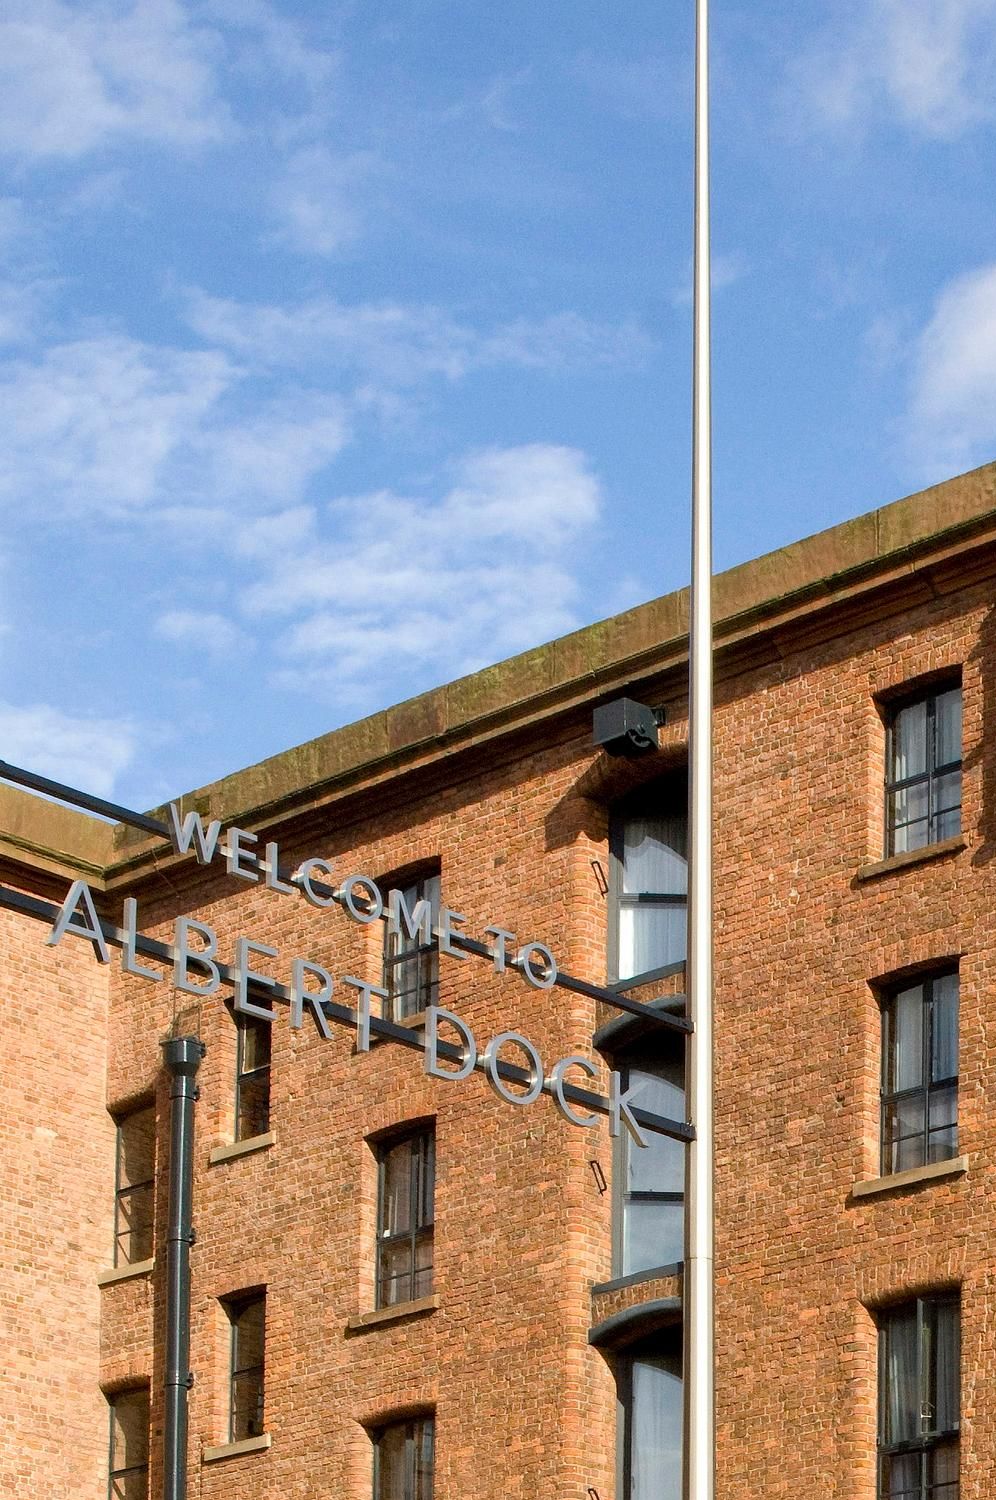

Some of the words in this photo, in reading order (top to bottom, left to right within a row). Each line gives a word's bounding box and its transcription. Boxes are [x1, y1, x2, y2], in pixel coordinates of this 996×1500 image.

[168, 802, 469, 960] WELCOME
[485, 925, 558, 989] TO
[45, 879, 390, 1053] ALBERT
[424, 1005, 650, 1149] DOCK
